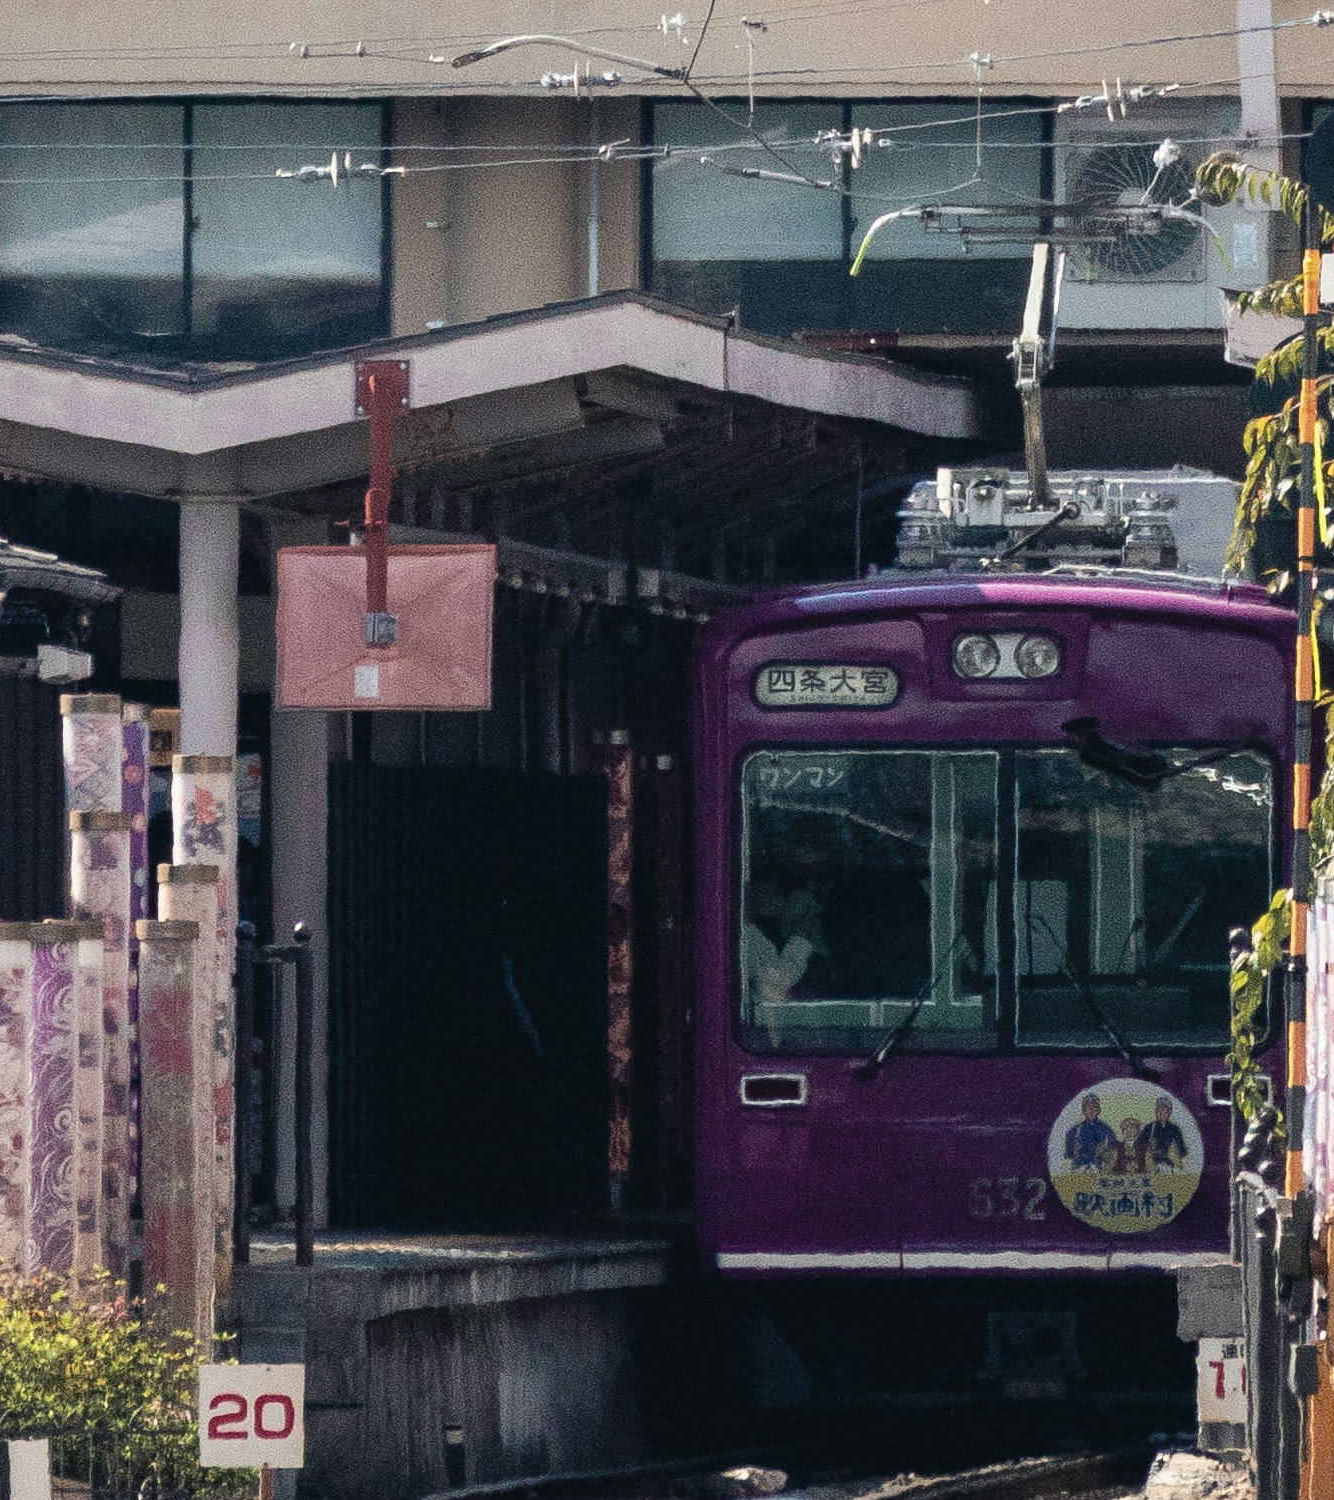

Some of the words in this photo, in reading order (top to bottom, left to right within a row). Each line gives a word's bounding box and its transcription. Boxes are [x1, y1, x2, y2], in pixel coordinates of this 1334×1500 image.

[767, 668, 889, 694] 四条大宮
[759, 766, 845, 788] ワンマン
[968, 1176, 1047, 1221] 632
[1074, 1190, 1174, 1218] 映画村
[207, 1392, 295, 1441] 20
